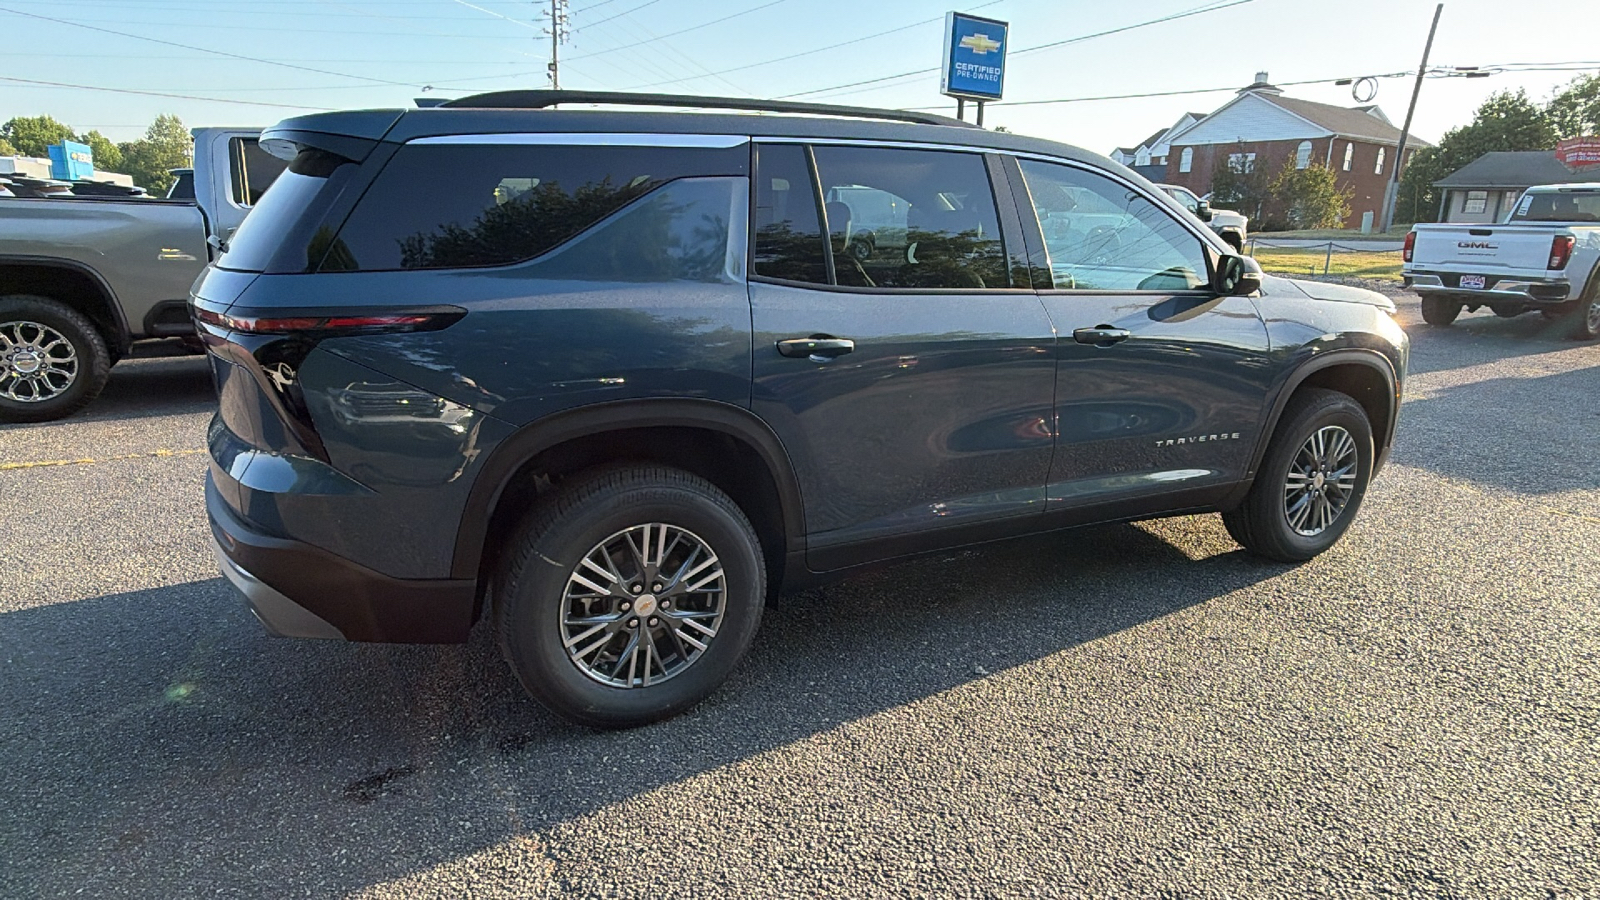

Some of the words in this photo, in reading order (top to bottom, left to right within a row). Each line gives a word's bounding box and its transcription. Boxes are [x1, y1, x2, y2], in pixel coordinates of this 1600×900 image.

[955, 62, 1001, 75] CERTIFIED
[956, 70, 998, 82] PRE-OWNED
[1457, 241, 1499, 249] GMC
[1155, 432, 1240, 447] TRAVERSE
